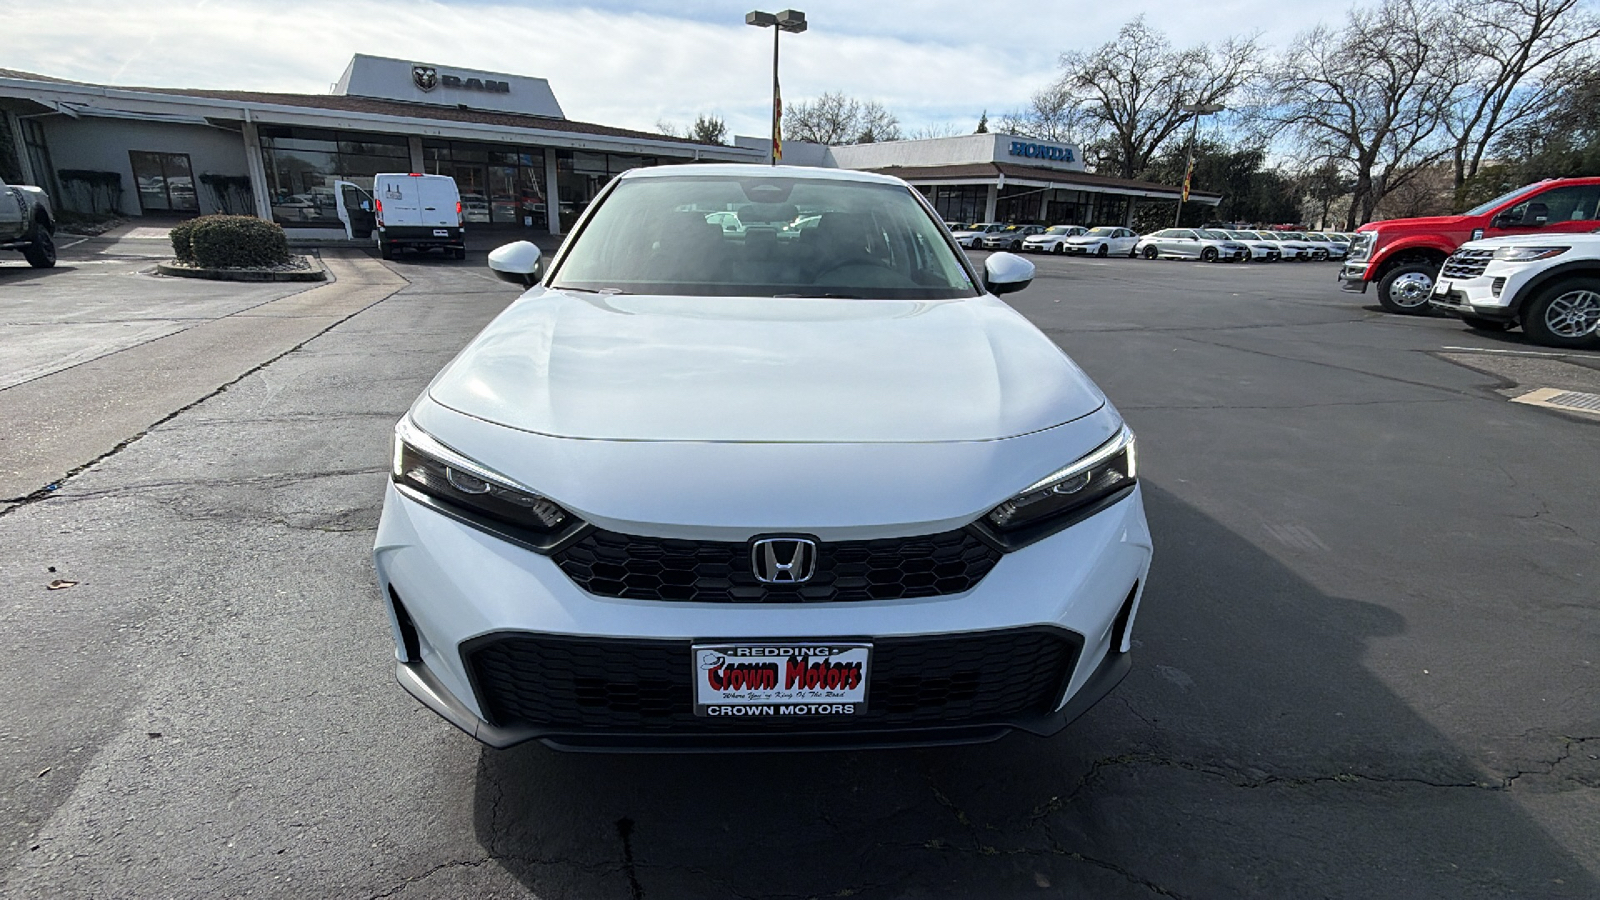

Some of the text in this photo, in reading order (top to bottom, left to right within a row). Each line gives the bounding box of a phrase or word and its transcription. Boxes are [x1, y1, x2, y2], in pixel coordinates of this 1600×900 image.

[441, 75, 510, 92] RAM
[1009, 141, 1075, 163] HONDA
[737, 647, 830, 656] REDDING
[708, 658, 862, 691] Crown Motors
[707, 704, 855, 716] CROWN MOTORS
